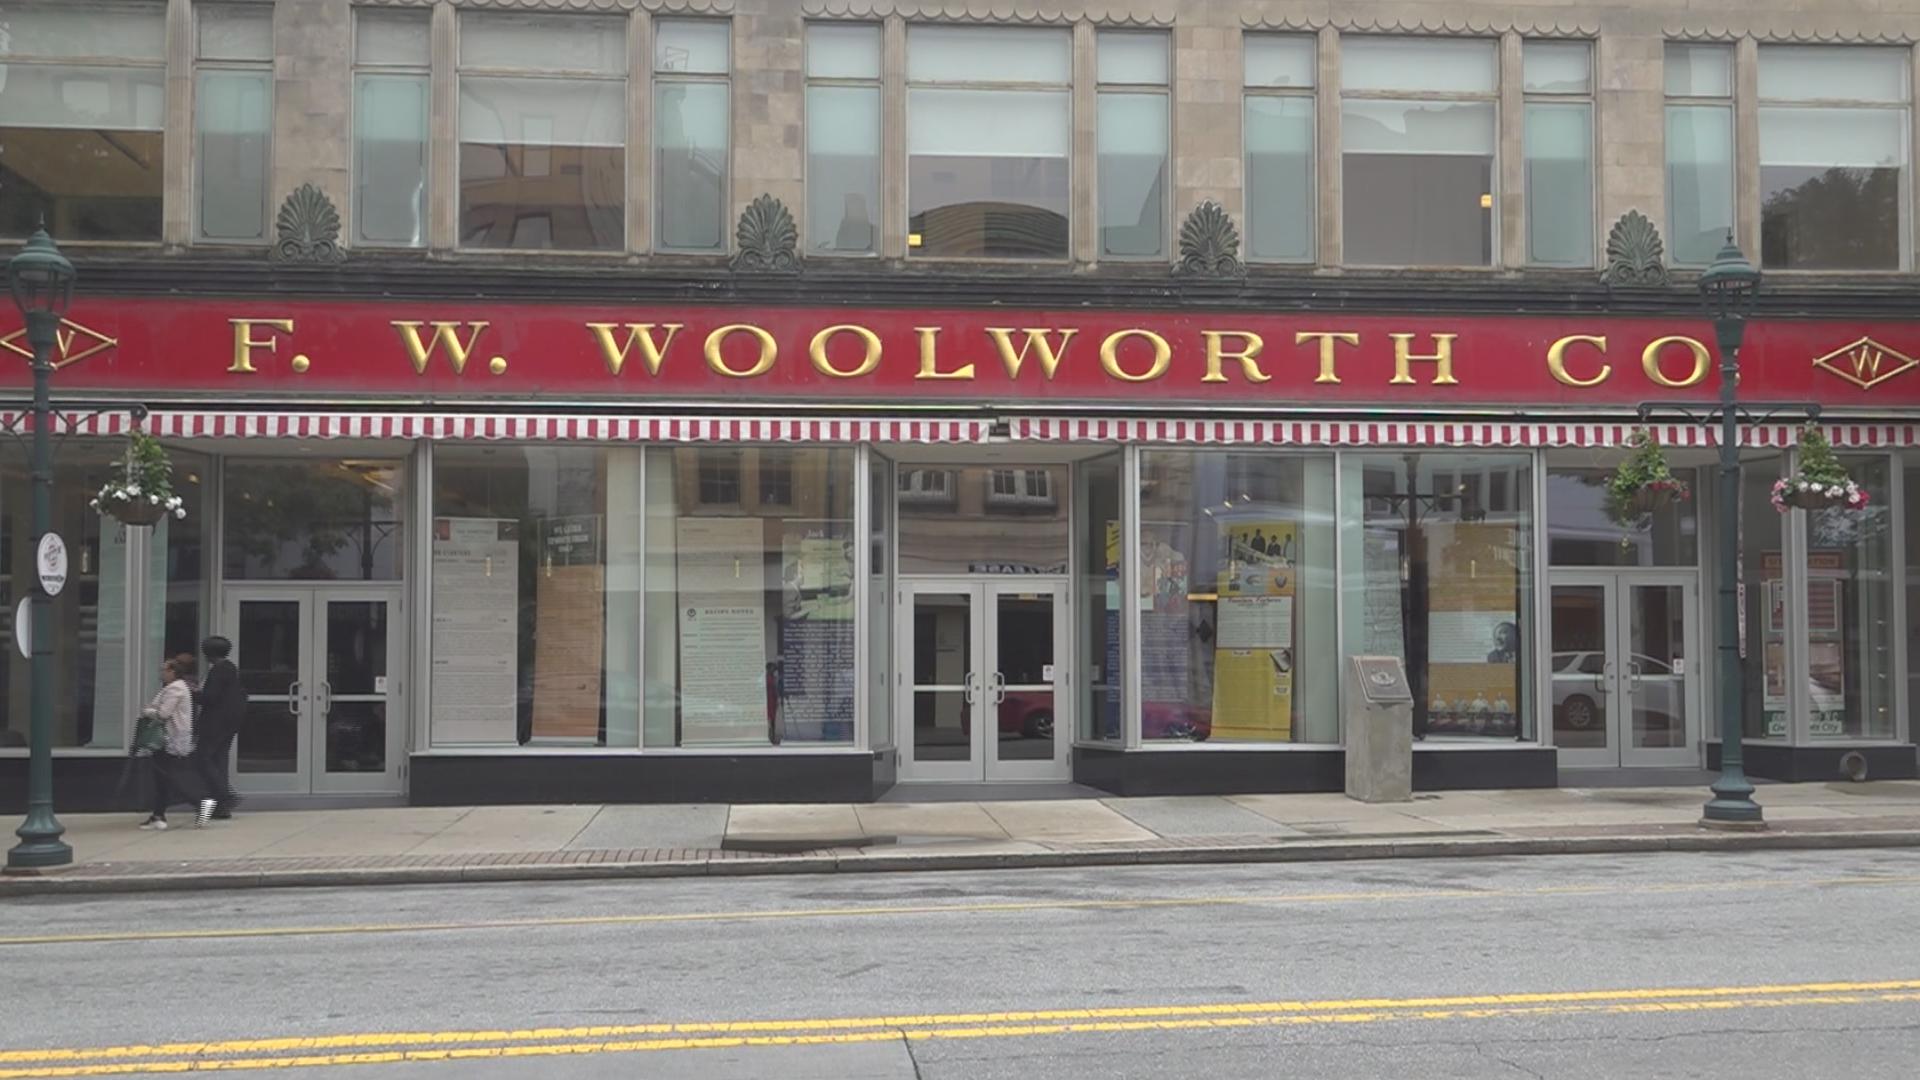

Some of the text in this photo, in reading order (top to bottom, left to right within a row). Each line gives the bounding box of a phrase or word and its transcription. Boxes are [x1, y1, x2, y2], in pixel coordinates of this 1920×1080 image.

[227, 317, 1741, 388] F. W. WOOLWORTH CO
[1848, 344, 1882, 378] W
